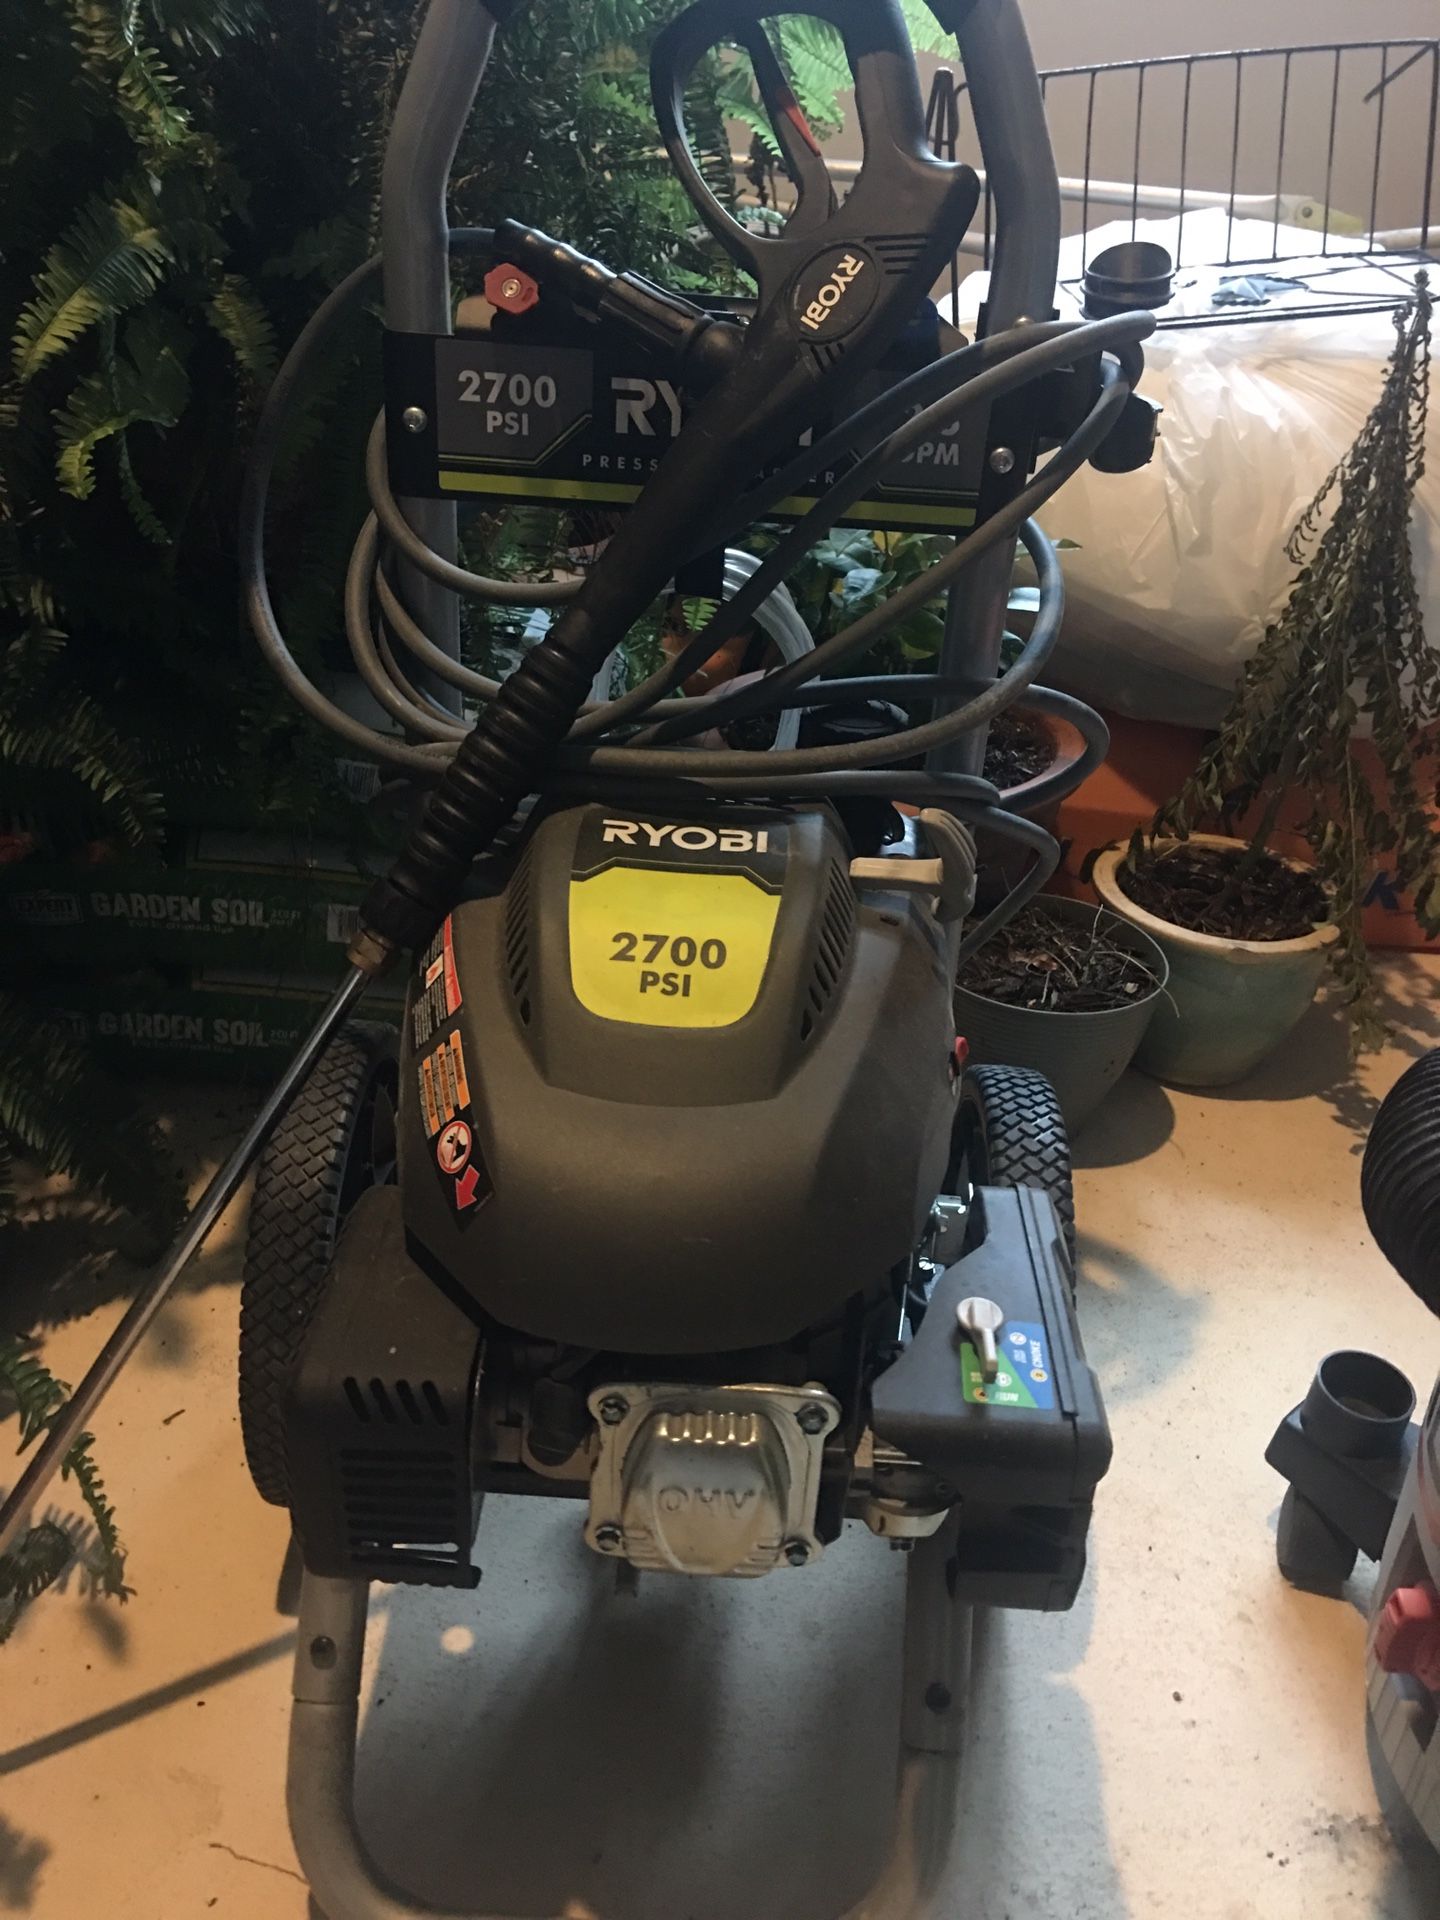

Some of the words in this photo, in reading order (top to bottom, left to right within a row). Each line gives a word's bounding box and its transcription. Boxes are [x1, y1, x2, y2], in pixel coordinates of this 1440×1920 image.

[800, 254, 865, 331] RYOBI
[457, 369, 556, 409] 2700
[486, 410, 530, 436] PSI
[582, 453, 660, 471] PRESS
[901, 442, 960, 466] PM
[602, 818, 769, 854] RYOBI
[90, 891, 201, 922] GARDEN
[211, 897, 271, 929] SOIL
[609, 932, 727, 970] 2700
[639, 970, 691, 997] PSI
[97, 1011, 203, 1042] GARDEN
[213, 1017, 270, 1048] SOIL
